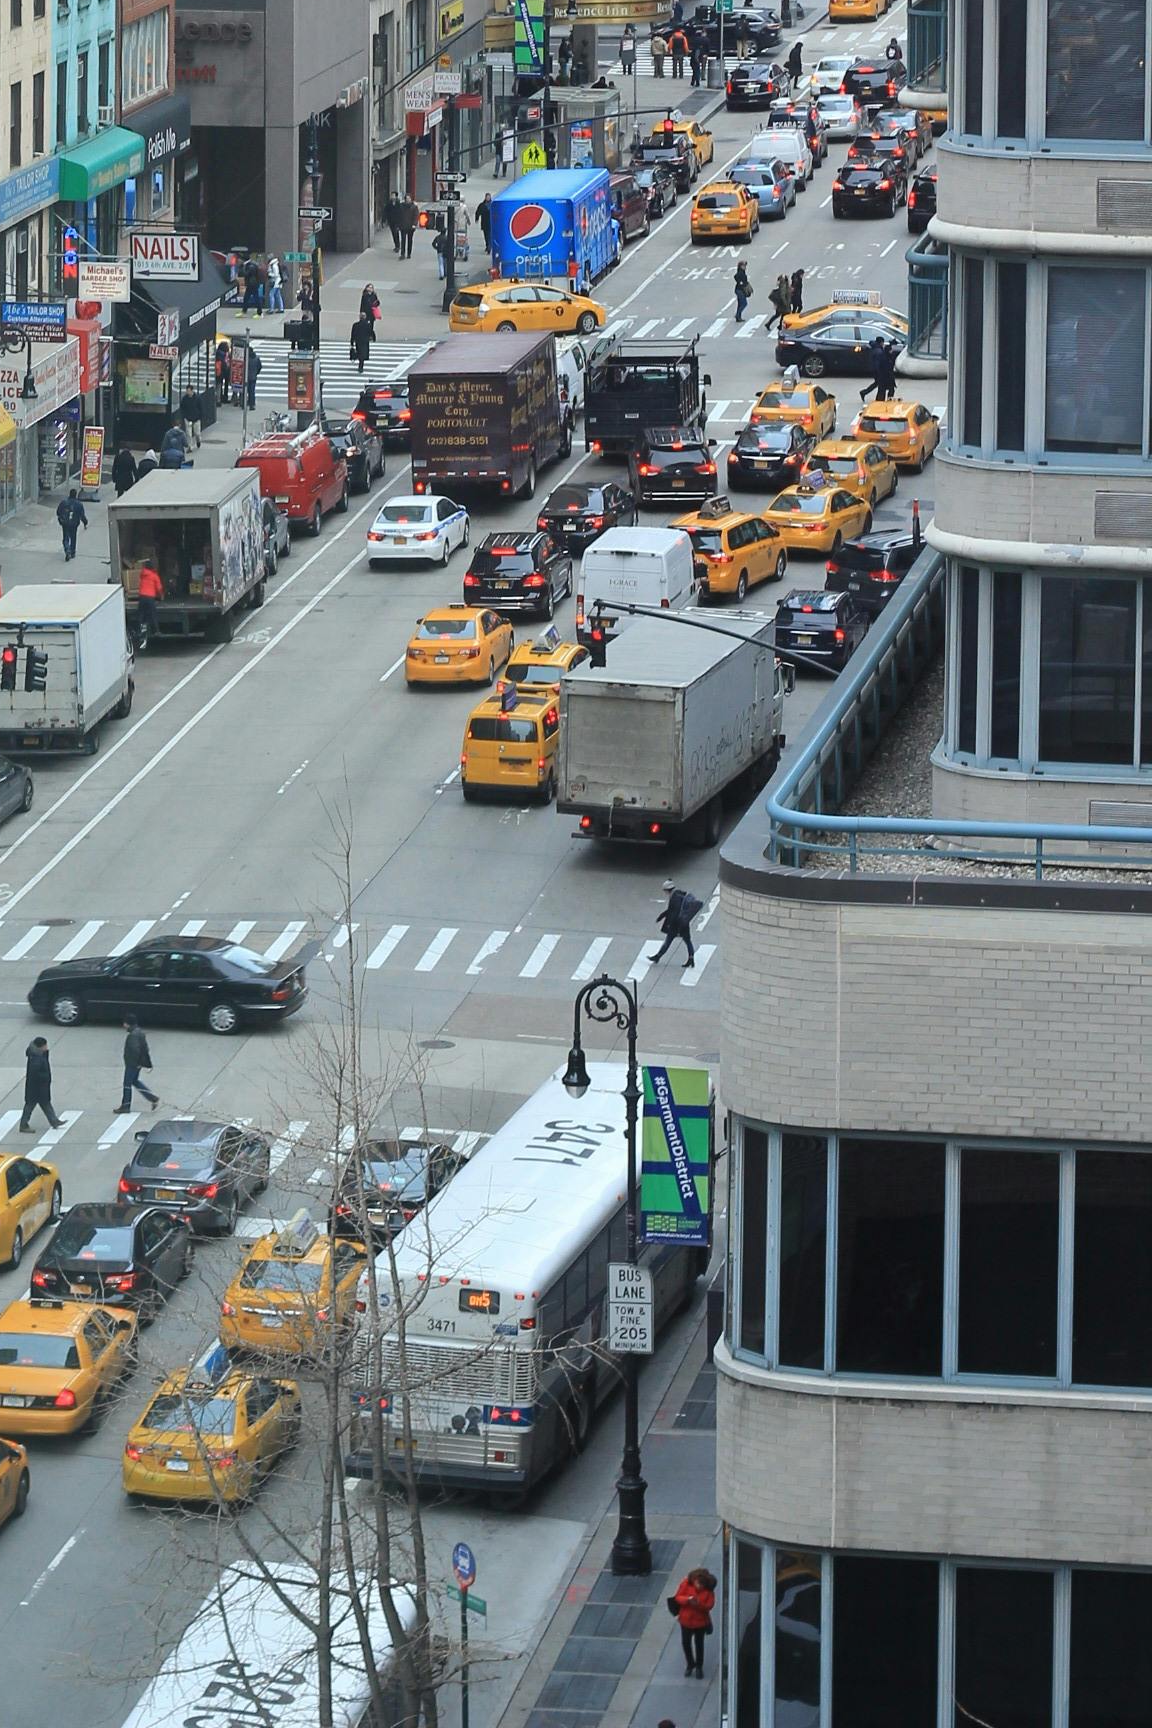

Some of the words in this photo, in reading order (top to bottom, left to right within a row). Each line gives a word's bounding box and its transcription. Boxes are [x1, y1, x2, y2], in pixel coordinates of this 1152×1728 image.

[606, 5, 629, 17] Inn
[435, 73, 460, 81] PRATO
[405, 90, 431, 99] MEN'S
[405, 99, 431, 109] WEAR
[148, 131, 166, 163] Polish
[165, 127, 176, 152] Me
[133, 237, 190, 261] NAILS
[87, 266, 124, 275] Michael's
[27, 306, 47, 316] TAILOR
[48, 306, 65, 316] SHOP
[7, 315, 29, 323] Custom
[150, 346, 178, 356] NAILS
[415, 394, 455, 405] Murray
[444, 405, 472, 416] Corp.
[427, 418, 488, 429] PORTOVAULT
[512, 1119, 616, 1167] 3471
[654, 1076, 694, 1199] #GarmentDistrict
[618, 1269, 642, 1282] BUS
[615, 1286, 646, 1299] LANE
[615, 1306, 634, 1315] TOW
[639, 1306, 646, 1315] &
[427, 1319, 456, 1333] 3471
[620, 1316, 641, 1325] FINE
[615, 1326, 647, 1340] $205
